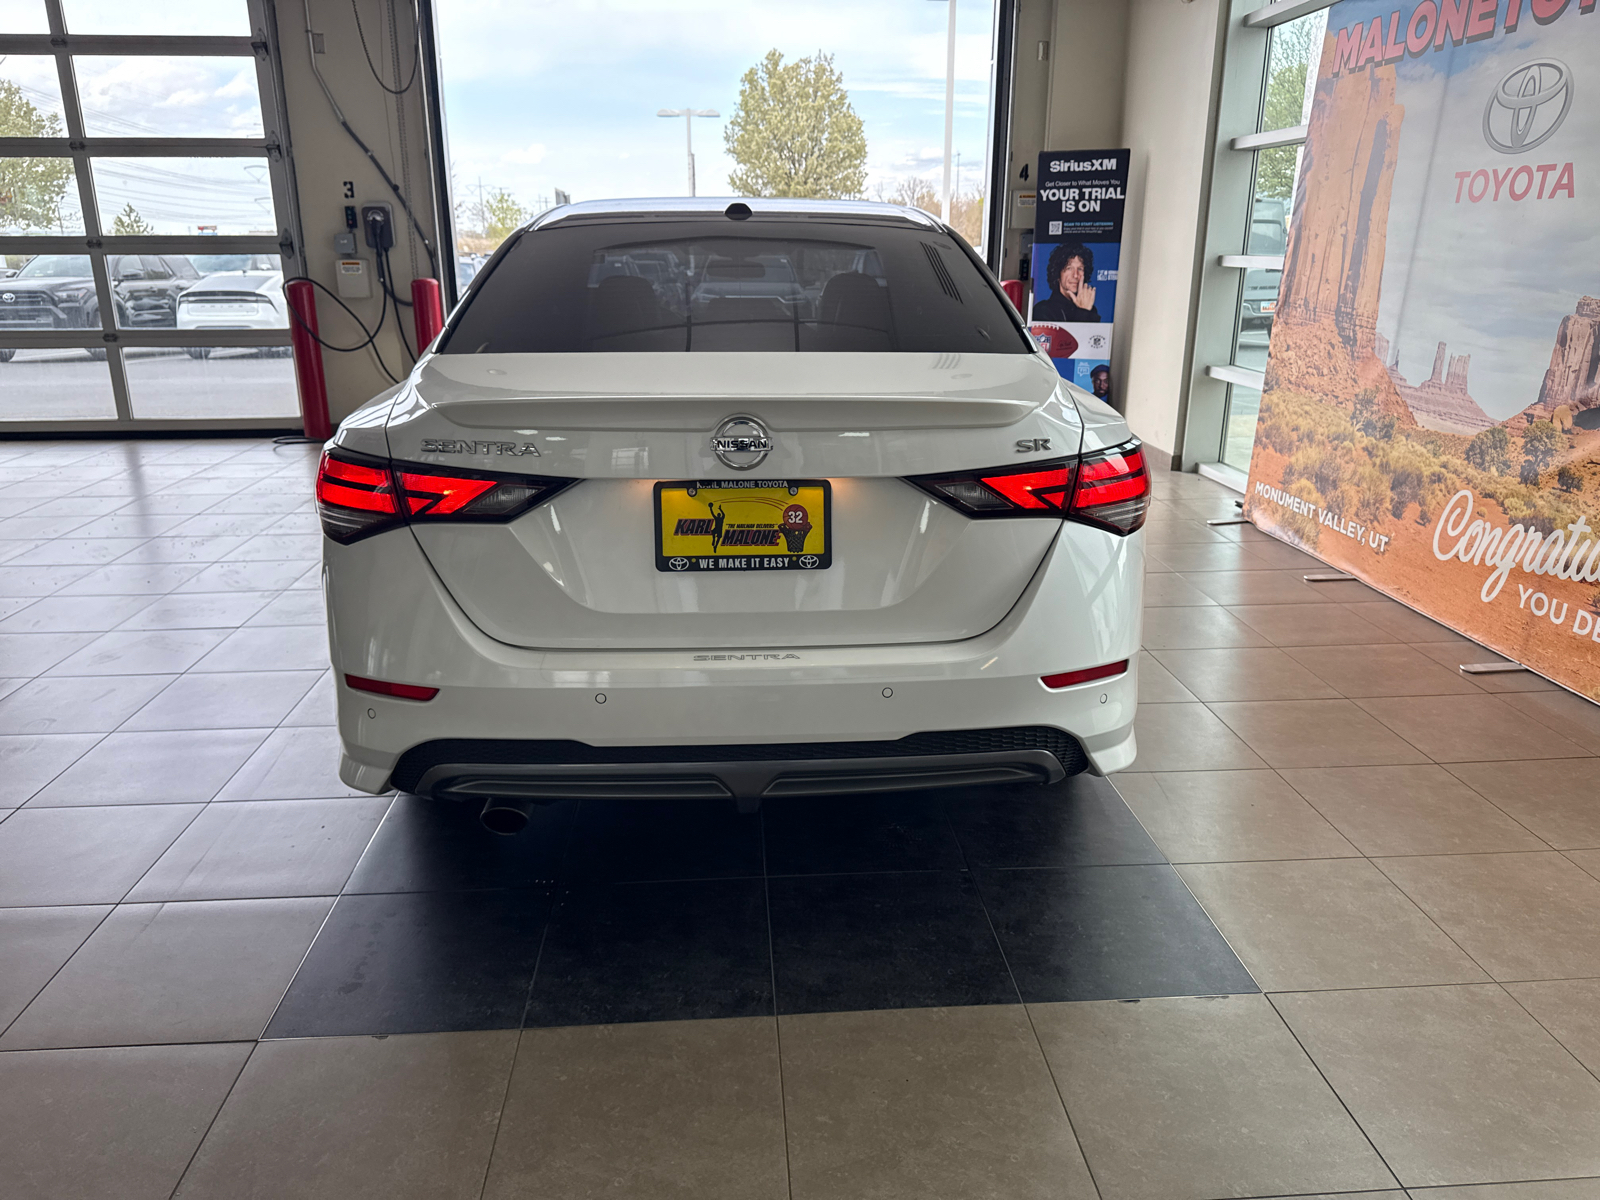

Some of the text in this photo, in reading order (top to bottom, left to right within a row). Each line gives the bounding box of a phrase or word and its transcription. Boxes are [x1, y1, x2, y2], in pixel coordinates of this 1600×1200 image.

[1019, 163, 1029, 181] 4
[1050, 158, 1117, 172] SiriusXM
[343, 181, 354, 199] 3
[1454, 162, 1575, 204] TOYOTA
[1040, 188, 1079, 201] YOUR
[1082, 187, 1125, 200] TRIAL
[1062, 200, 1100, 212] IS ON
[420, 438, 541, 457] SENTRA
[717, 440, 767, 449] NISSAN
[1016, 438, 1051, 453] SR
[788, 511, 803, 523] 32
[1255, 481, 1389, 552] MONUMENT VALLEY, UT
[674, 519, 714, 536] KARL
[720, 529, 781, 546] MALONE
[699, 558, 789, 568] WE MAKE IT EASY
[1518, 584, 1568, 624] YOU
